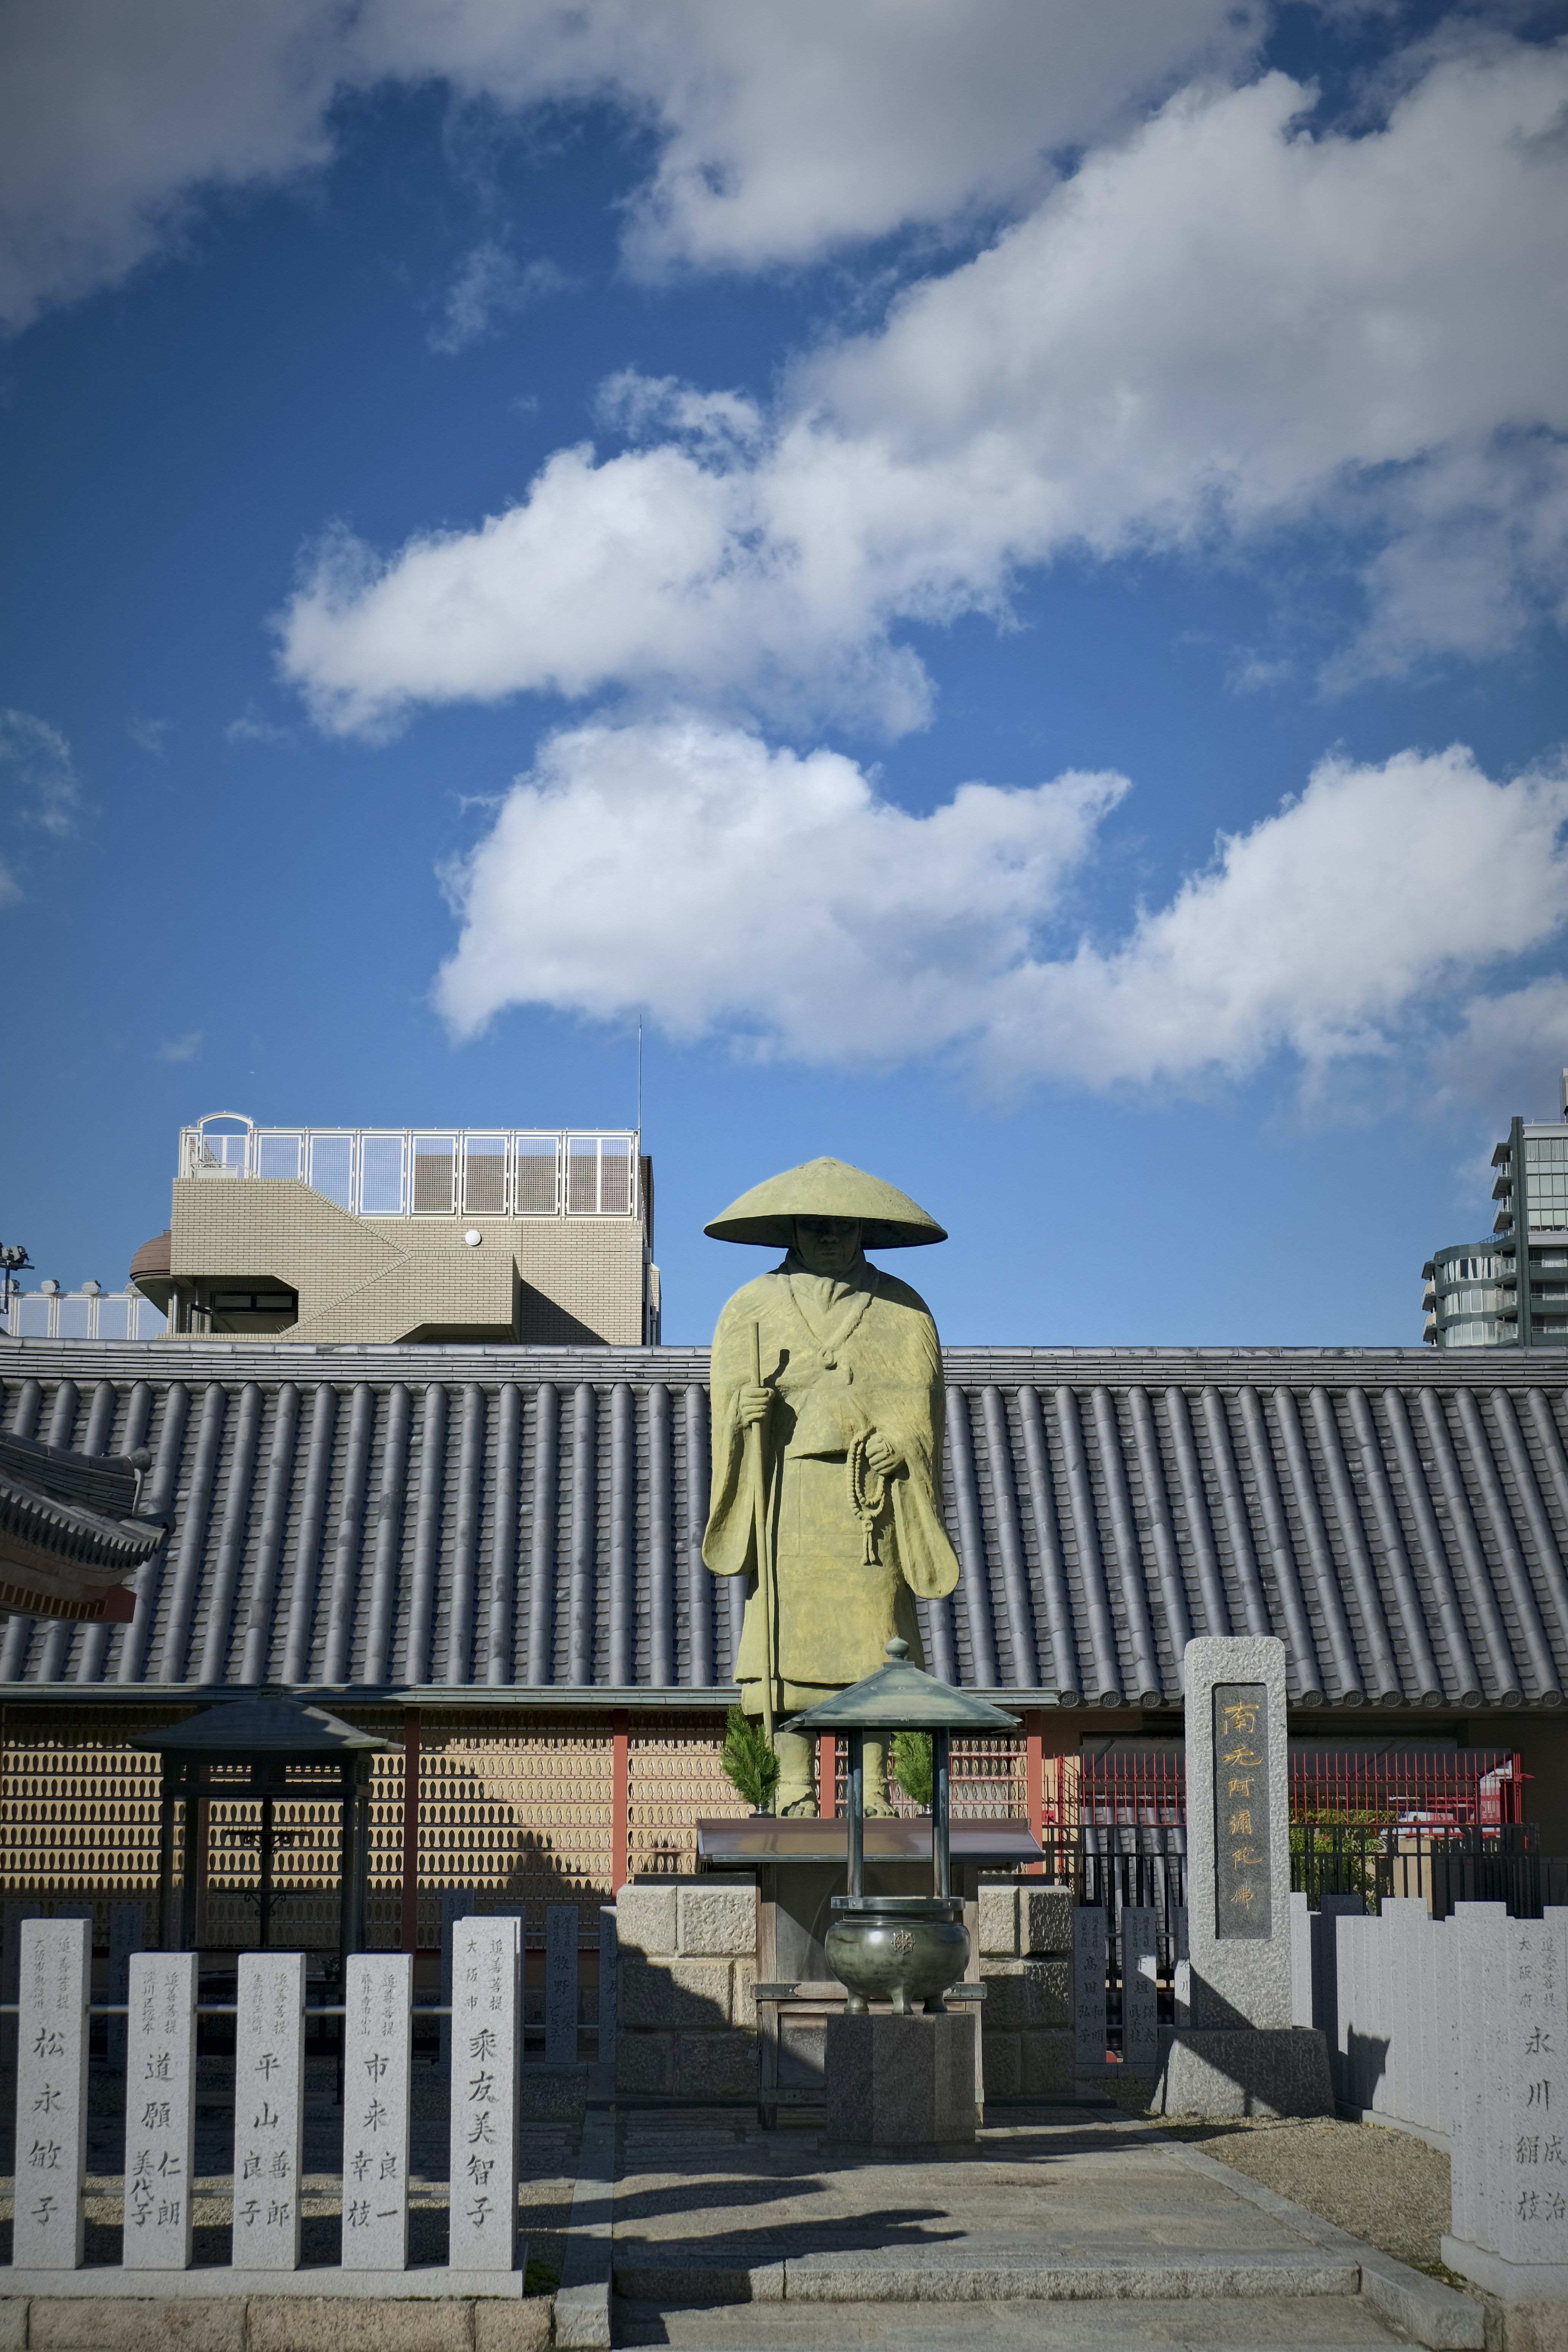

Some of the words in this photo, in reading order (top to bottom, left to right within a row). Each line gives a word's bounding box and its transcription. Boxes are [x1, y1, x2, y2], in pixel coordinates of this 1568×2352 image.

[57, 1937, 71, 2009] 追善菩提
[164, 1972, 179, 2034] 追善菩提
[273, 1973, 289, 2035] 追善菩提
[361, 1973, 373, 2035] 藤井寺市小山
[381, 1973, 397, 2036] 追善菩提
[466, 1939, 478, 2011] 大阪市
[489, 1939, 503, 2011] 追善菩提
[1518, 1937, 1533, 2008] 大阪府
[1541, 1937, 1557, 2007] 追善菩提
[141, 2052, 174, 2129] 道願
[254, 2052, 281, 2129] 平山
[363, 2053, 390, 2132] 市来
[1525, 2026, 1554, 2112] 永川
[29, 2027, 66, 2226] 松永敏子
[130, 2149, 155, 2227] 美代子
[157, 2150, 181, 2226] 仁朗
[239, 2150, 263, 2227] 良子
[267, 2150, 291, 2228] 善郎
[347, 2150, 374, 2227] 幸枝
[376, 2151, 398, 2217] 良一
[1516, 2136, 1539, 2221] 絹枝
[1544, 2134, 1567, 2221] 成治
